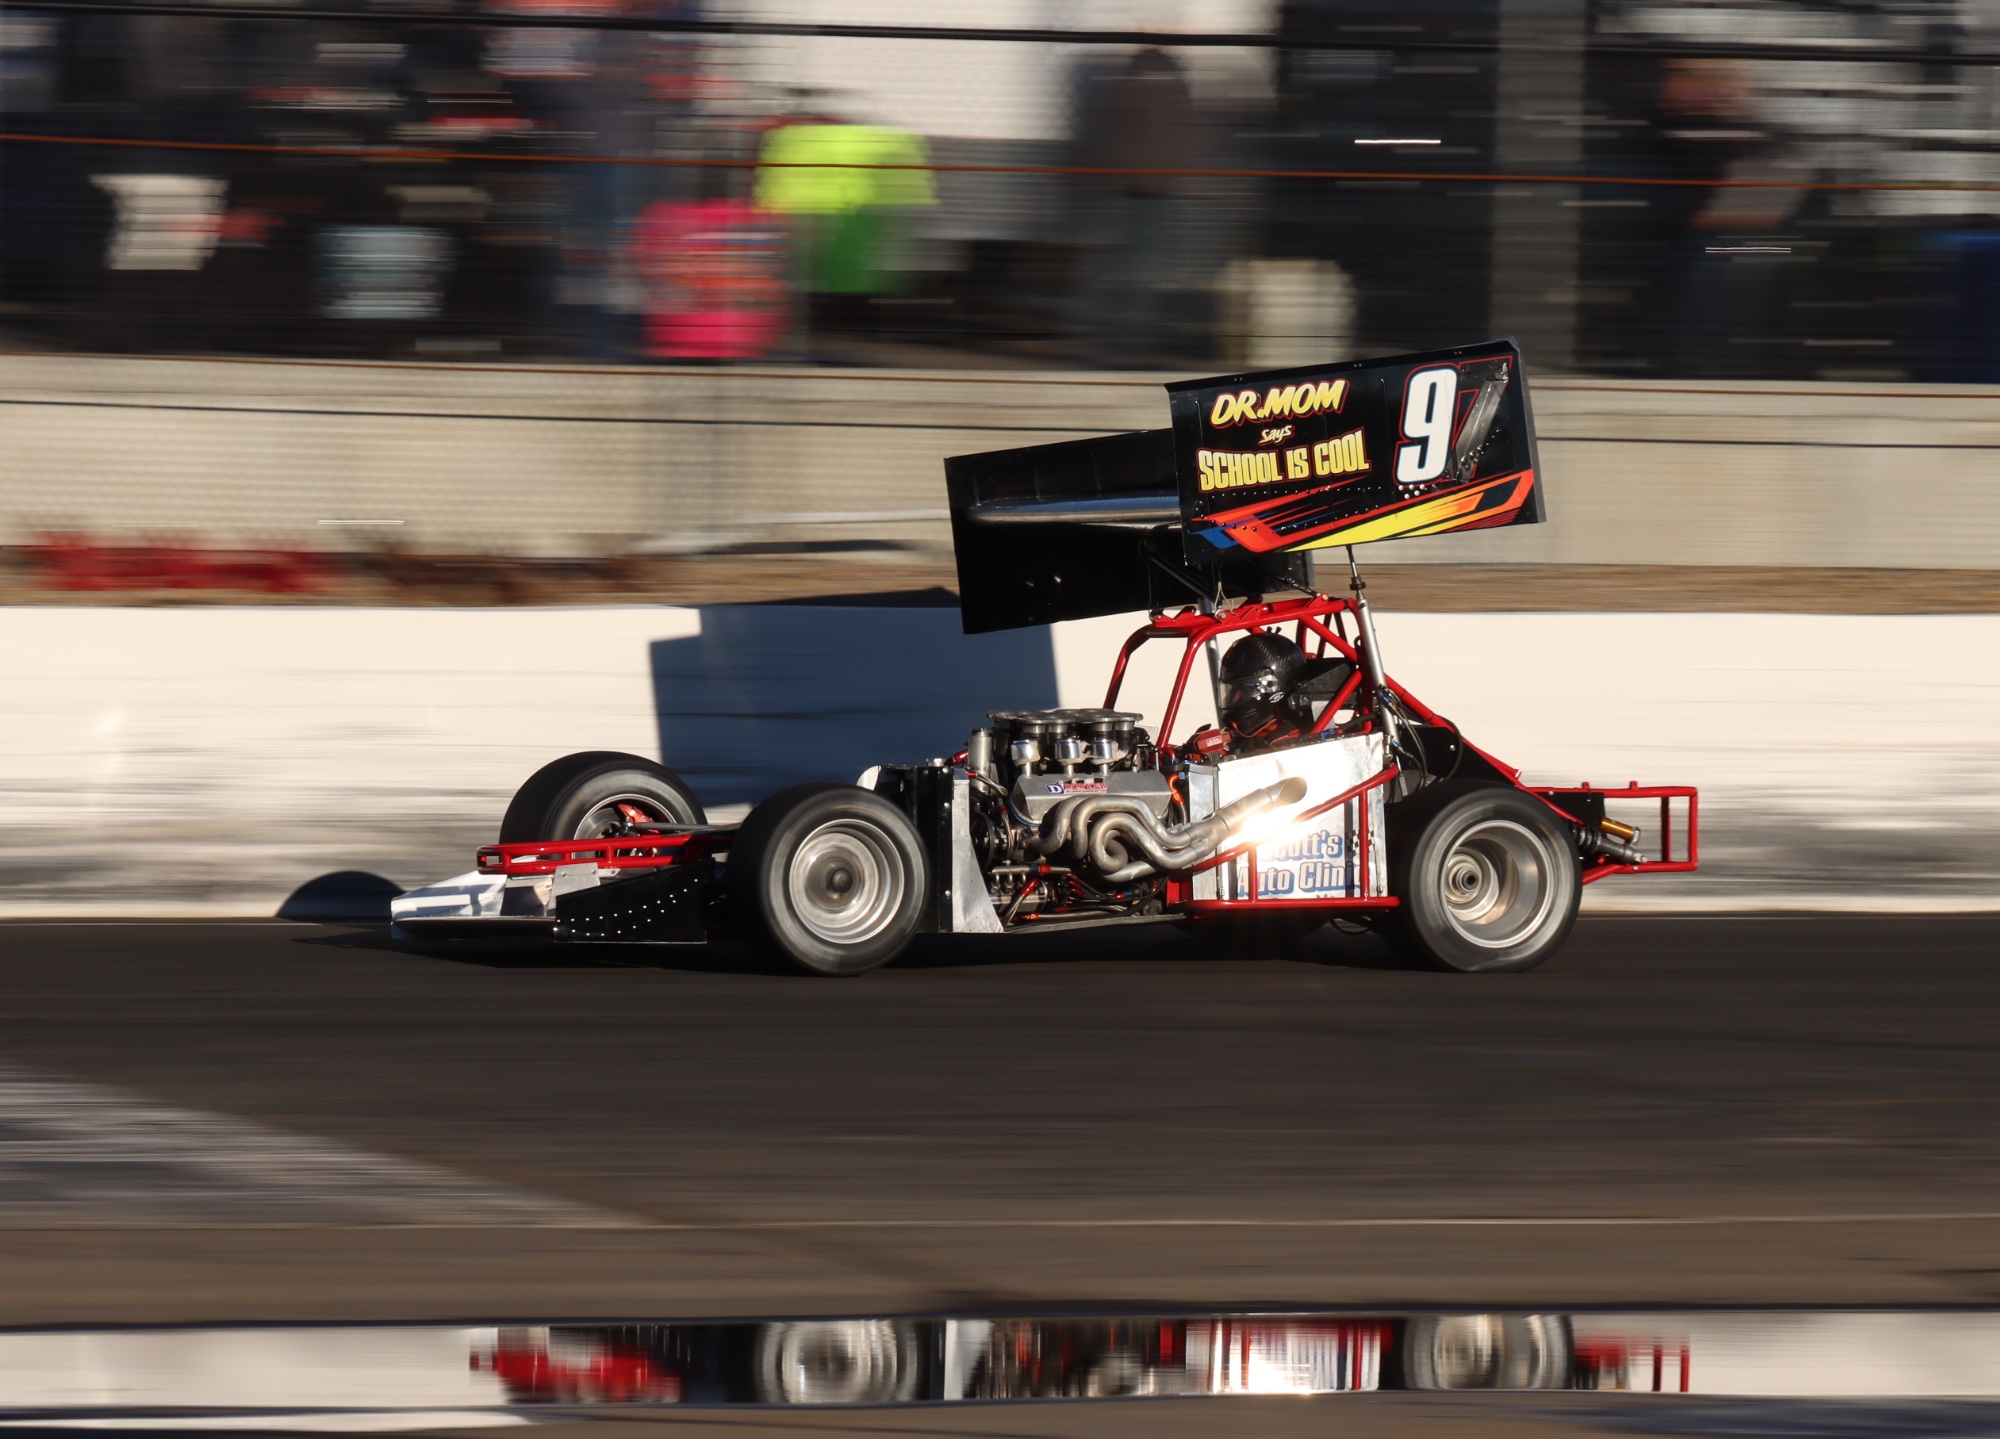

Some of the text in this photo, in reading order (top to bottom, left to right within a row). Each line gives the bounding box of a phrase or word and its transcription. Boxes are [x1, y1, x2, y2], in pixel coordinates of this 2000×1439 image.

[1210, 379, 1348, 427] DR.MOM
[1258, 425, 1294, 444] says
[1197, 430, 1370, 491] SCHOOL IS COOL
[1238, 866, 1294, 897] Auto
